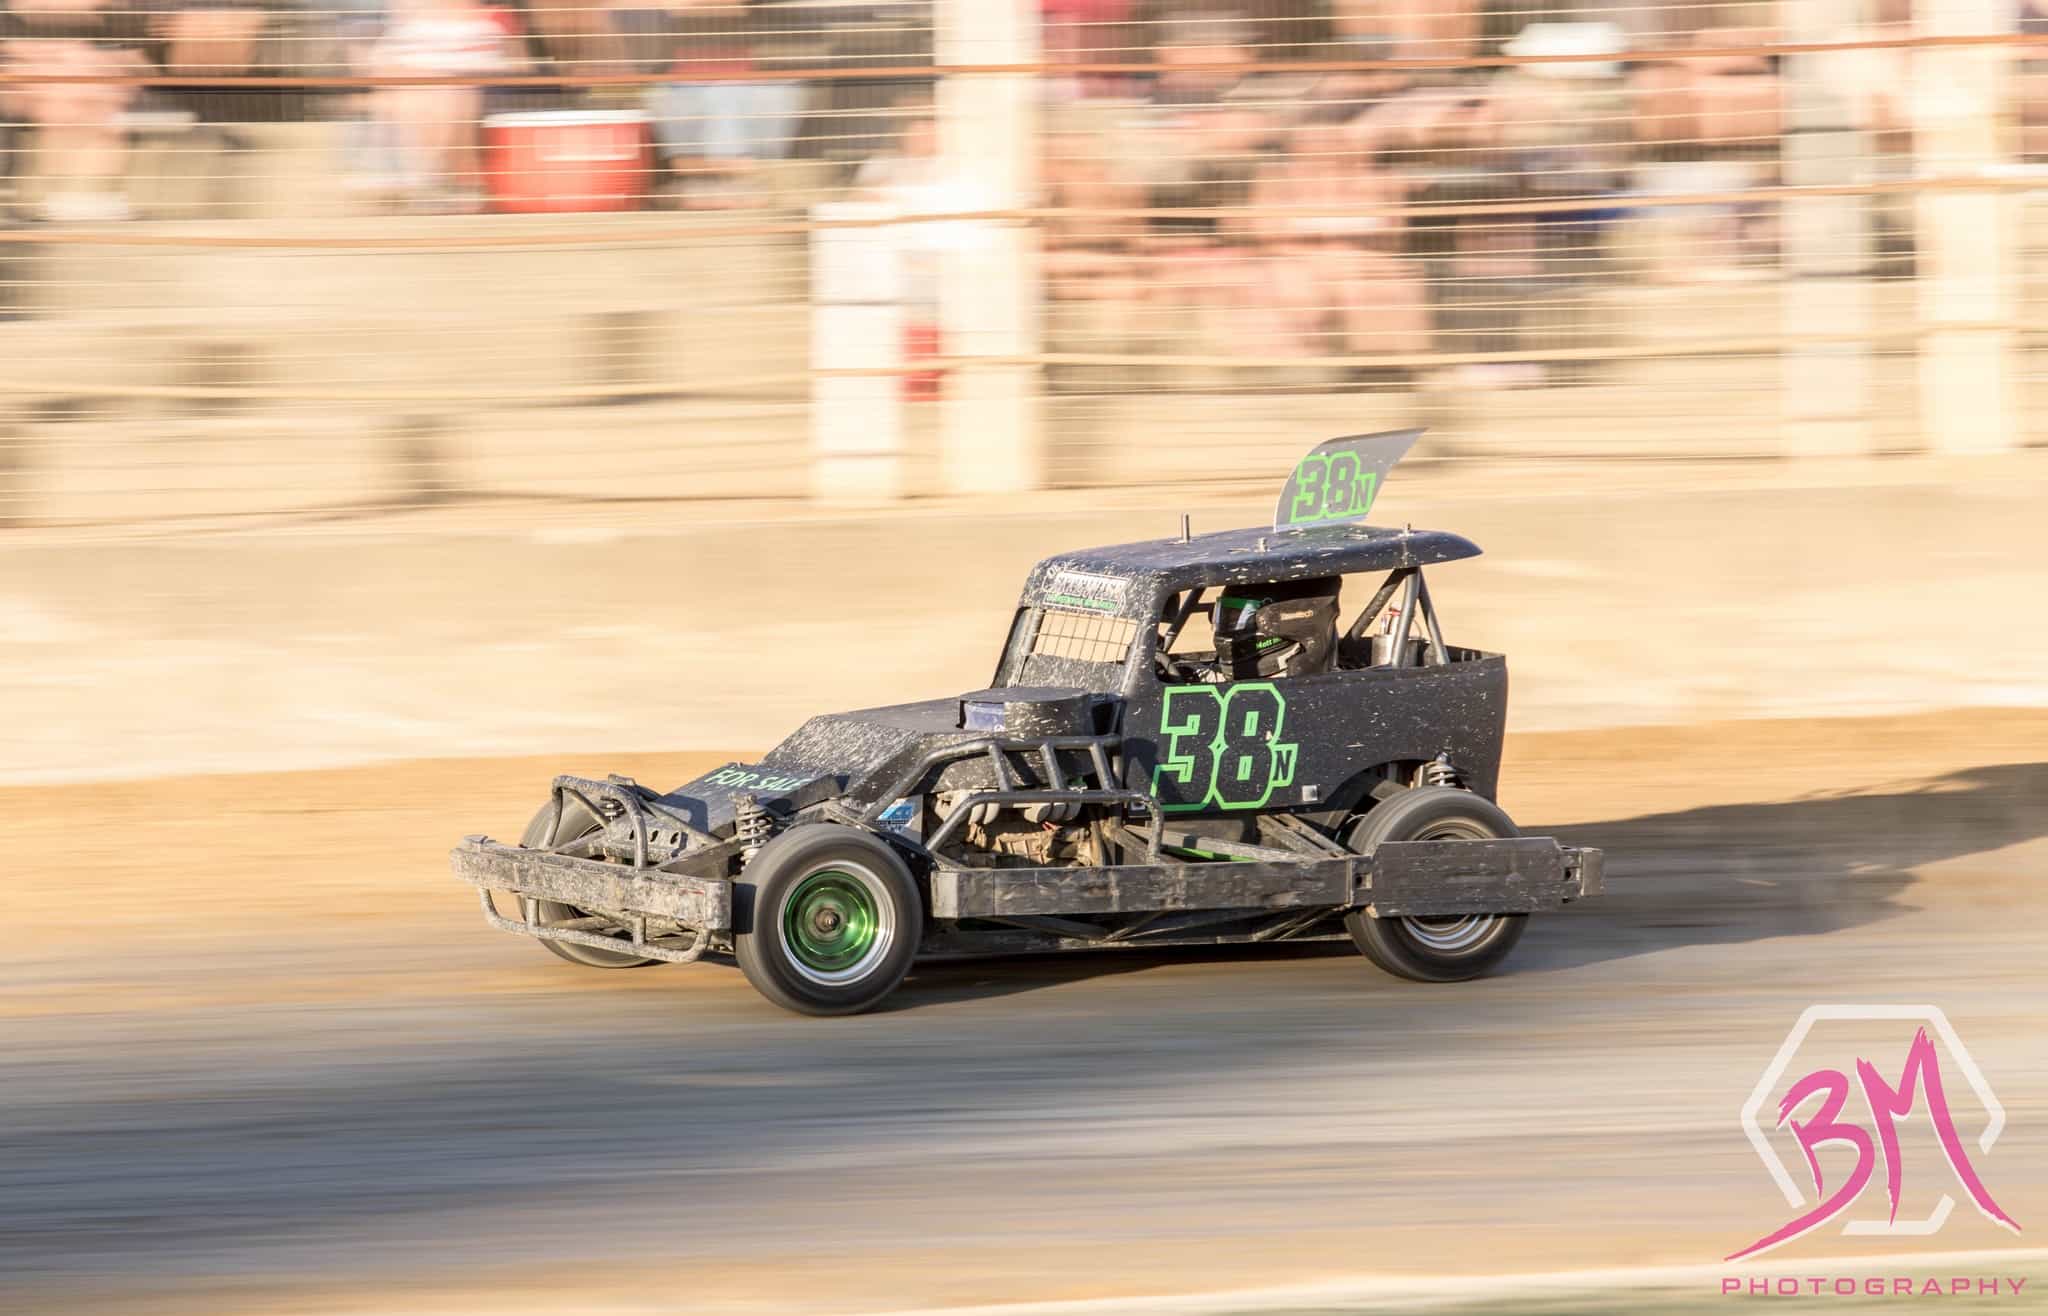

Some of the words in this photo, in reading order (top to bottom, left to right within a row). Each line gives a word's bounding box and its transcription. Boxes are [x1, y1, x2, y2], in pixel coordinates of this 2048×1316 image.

[1290, 451, 1377, 523] 38N
[704, 769, 760, 788] FOR
[1150, 682, 1299, 812] 38N
